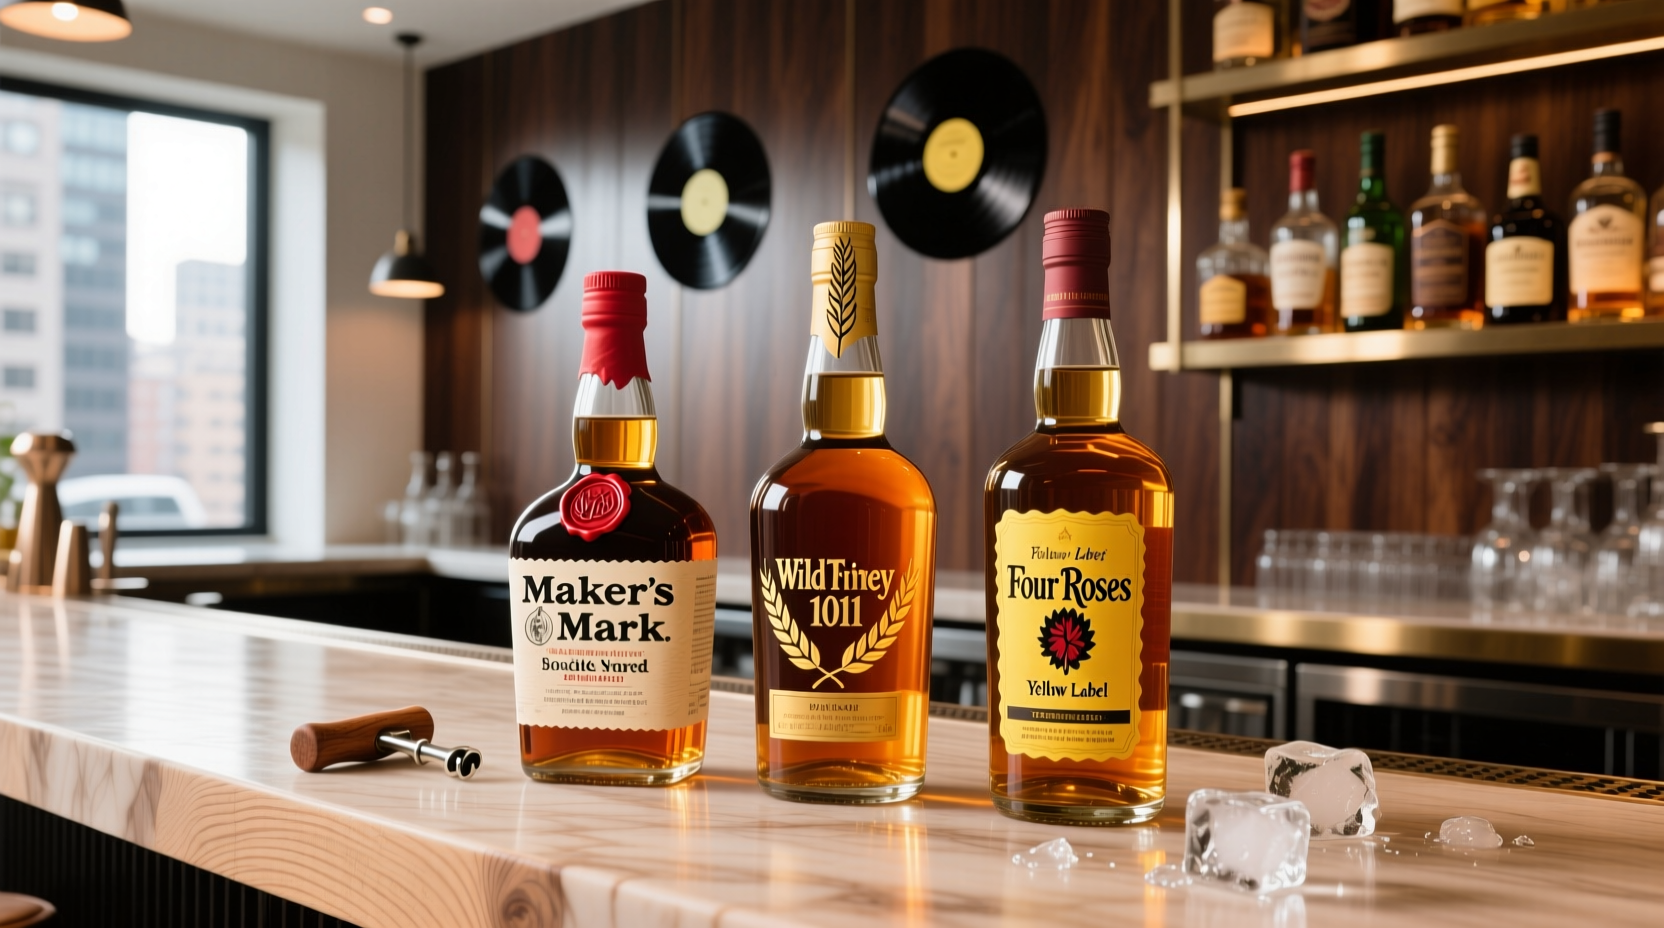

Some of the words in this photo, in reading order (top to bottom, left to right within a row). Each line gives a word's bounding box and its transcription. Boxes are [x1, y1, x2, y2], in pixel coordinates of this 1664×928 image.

[775, 558, 826, 590] Wild
[1007, 564, 1059, 600] Four
[1061, 566, 1132, 609] Roses
[522, 575, 674, 606] Maker's
[557, 611, 671, 643] Mark.
[809, 594, 863, 628] 1011
[1071, 681, 1108, 698] Label
